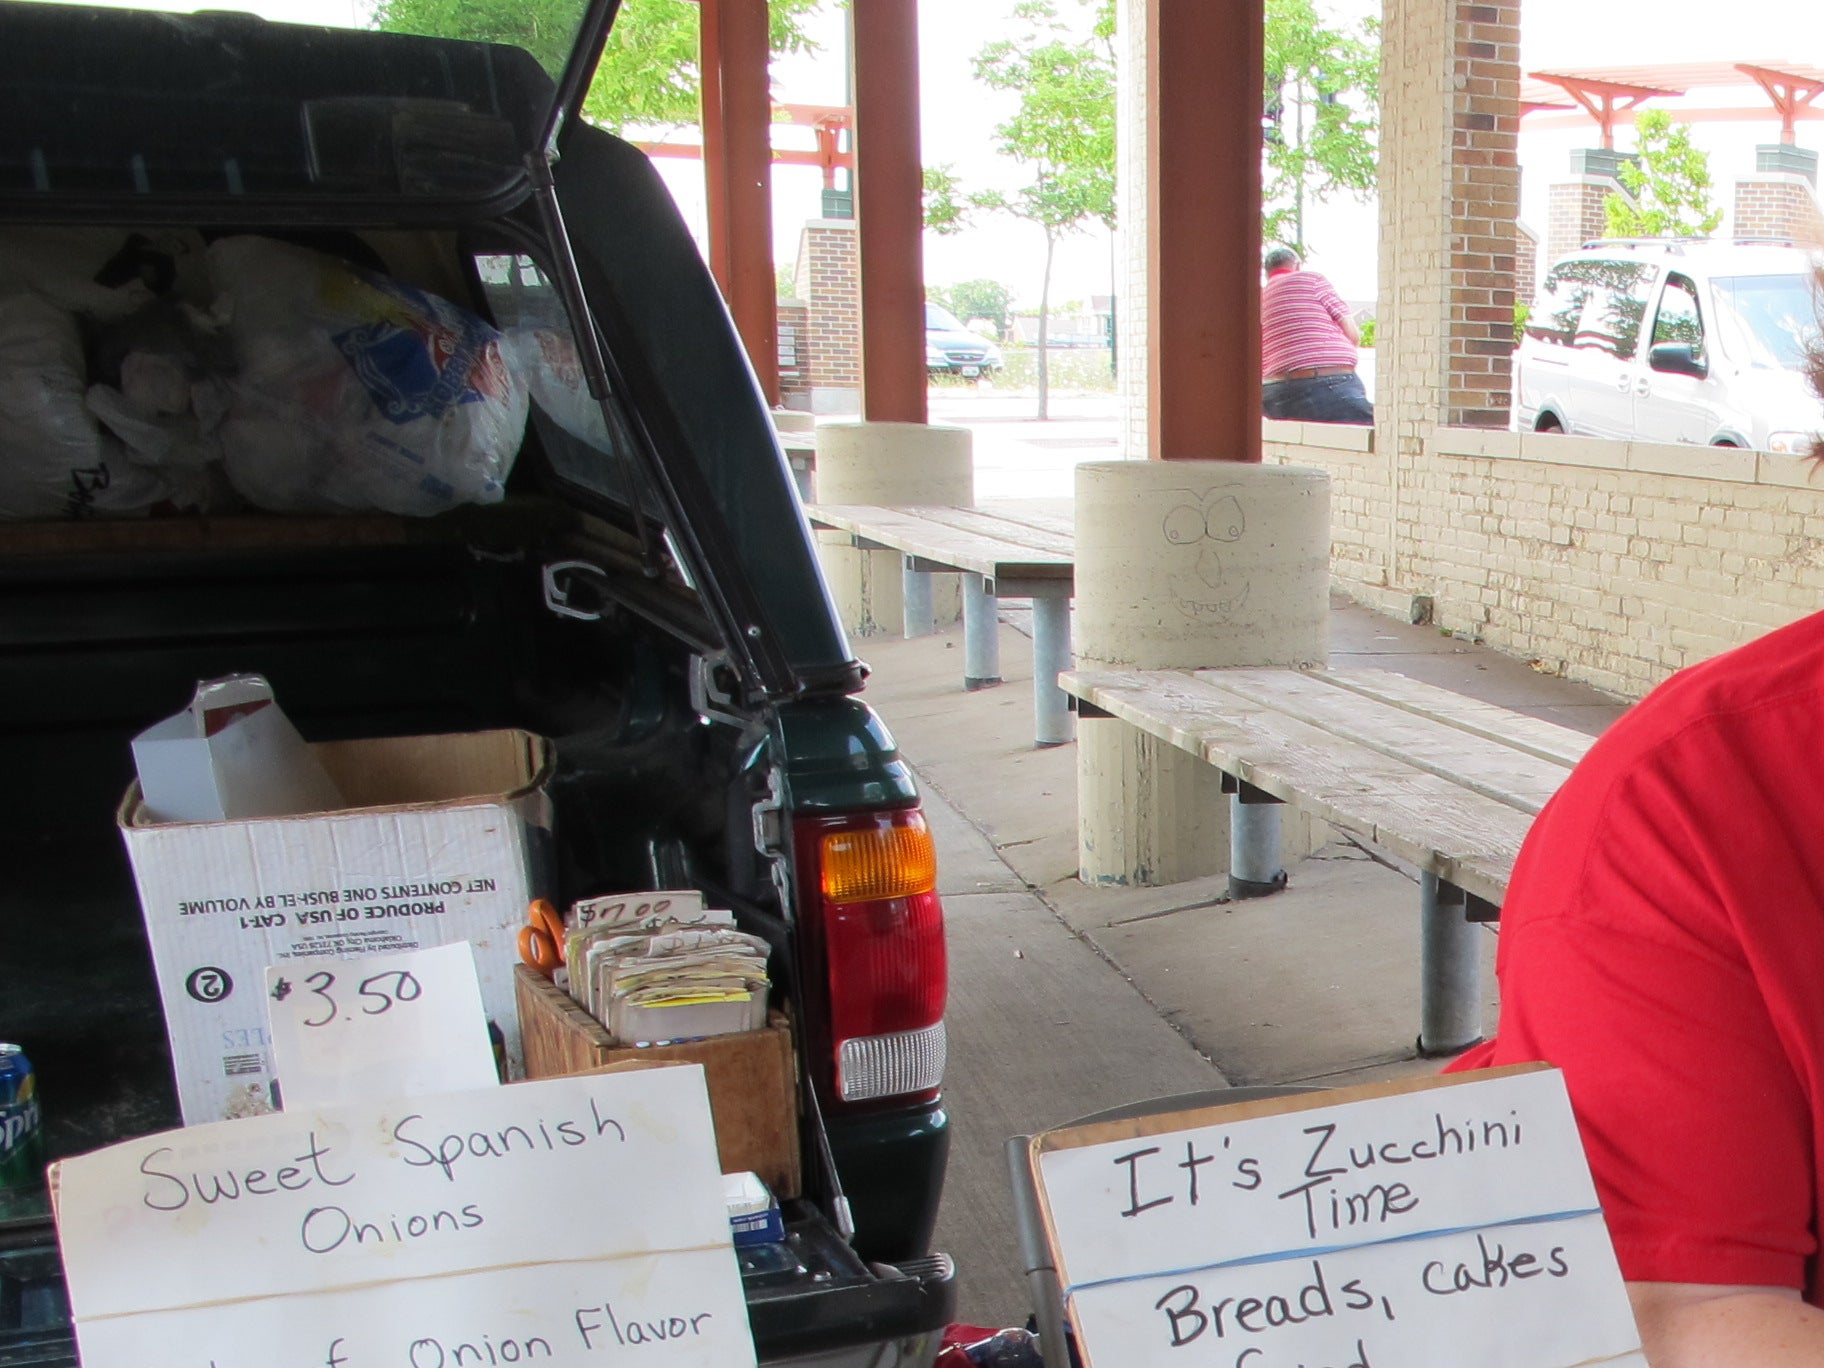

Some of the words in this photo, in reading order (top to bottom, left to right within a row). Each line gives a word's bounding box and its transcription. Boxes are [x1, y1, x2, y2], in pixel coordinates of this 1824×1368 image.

[383, 880, 463, 898] CONTENTS
[467, 877, 497, 893] NET
[255, 896, 275, 910] BY
[342, 888, 378, 902] ONE
[179, 897, 251, 916] VOLUME
[337, 908, 360, 923] OF
[364, 900, 446, 920] PRODUCE
[239, 912, 286, 930] CAT-1
[295, 910, 334, 926] USA
[270, 970, 423, 1027] $3.50
[140, 1131, 356, 1210] Sweet
[393, 1098, 626, 1182] Spanish
[1114, 1138, 1262, 1218] It's
[1302, 1110, 1523, 1178] Zucchini
[1279, 1176, 1420, 1239] Time
[301, 1203, 485, 1253] Onions
[1156, 1260, 1396, 1347] Breads,
[1422, 1234, 1569, 1298] cakes
[574, 1302, 714, 1350] Flavor
